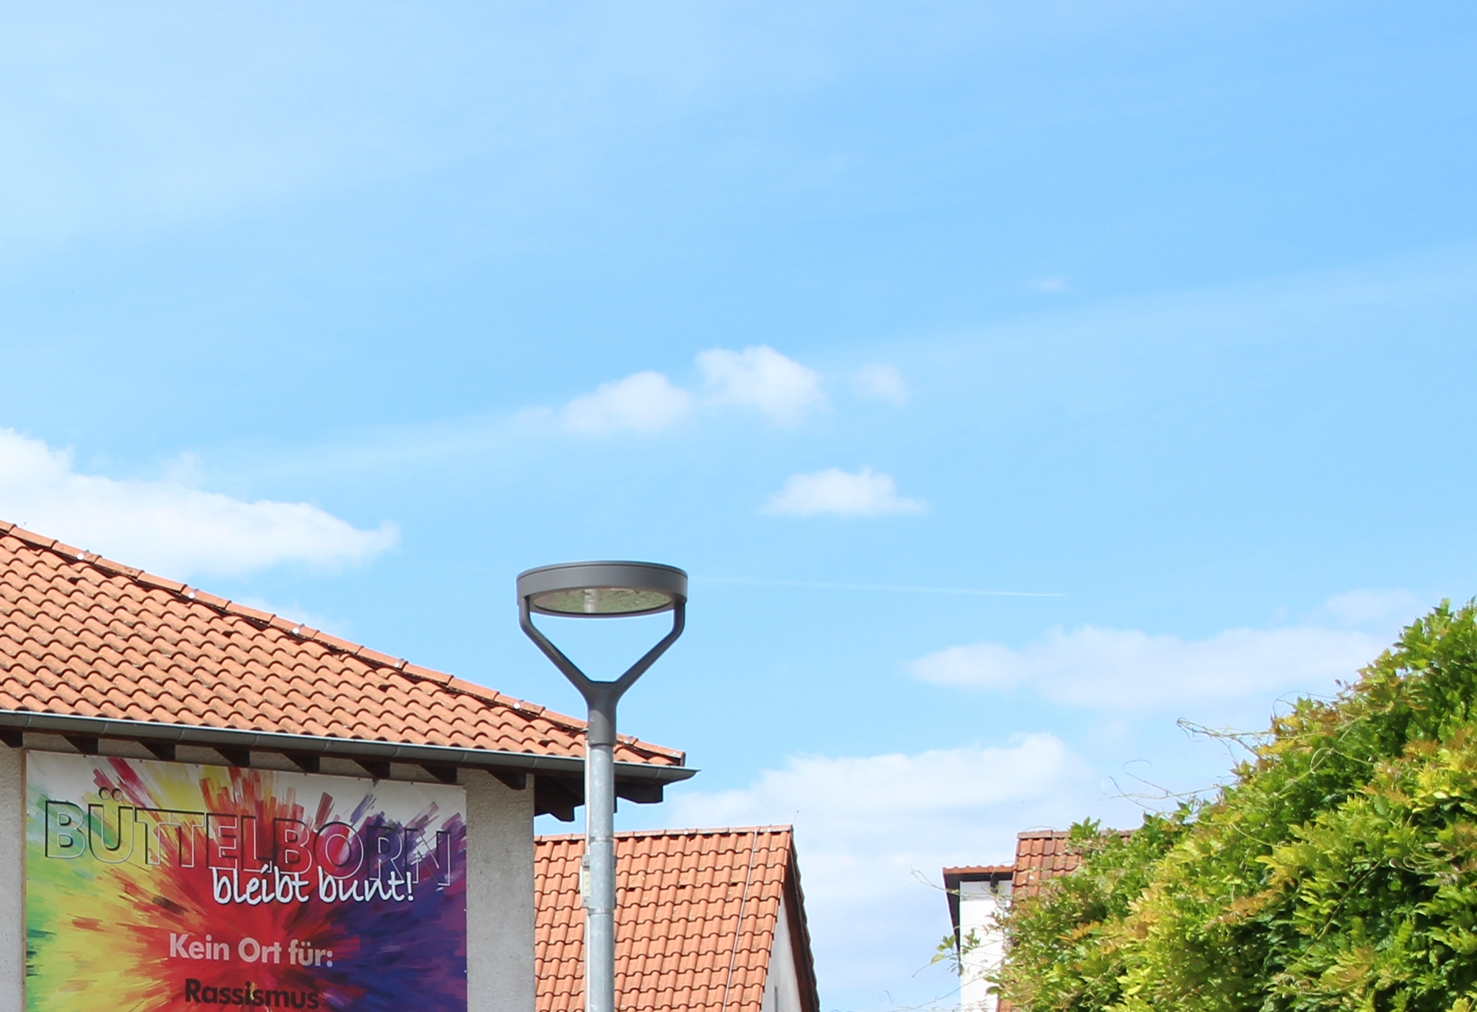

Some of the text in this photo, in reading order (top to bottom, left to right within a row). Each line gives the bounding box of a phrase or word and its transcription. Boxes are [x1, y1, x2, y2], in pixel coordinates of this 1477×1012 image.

[44, 786, 451, 887] BÜTTELBORN
[211, 863, 415, 906] bleibt bunt!
[169, 933, 334, 968] Kein Ort für:
[184, 978, 320, 1011] Rassismus
